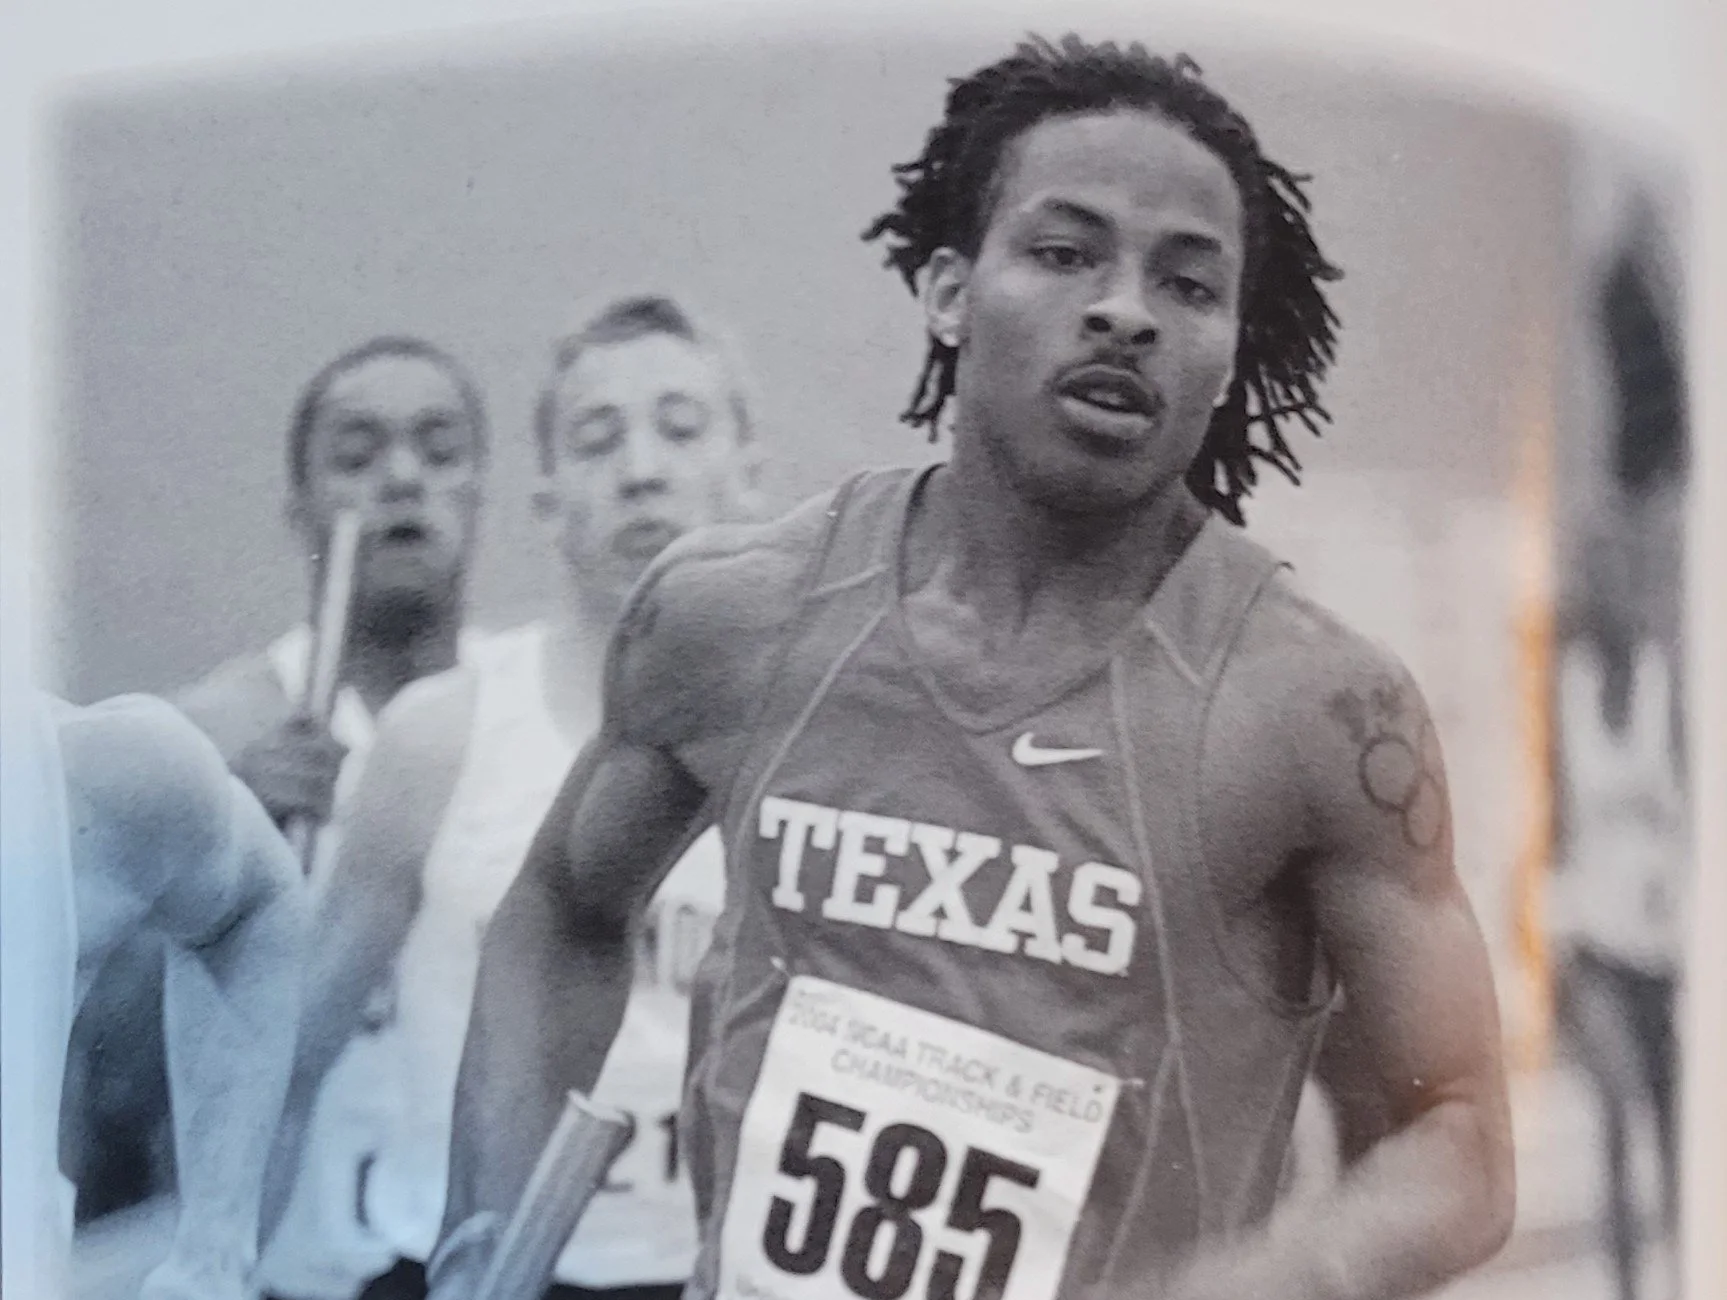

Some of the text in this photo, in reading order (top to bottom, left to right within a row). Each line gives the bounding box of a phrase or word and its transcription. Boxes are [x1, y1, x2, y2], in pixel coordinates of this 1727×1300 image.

[760, 797, 1142, 976] TEXAS
[831, 1048, 1035, 1133] CHAMPIONSHIPS
[917, 1041, 999, 1090] TRACK
[1030, 1082, 1103, 1123] FIELD
